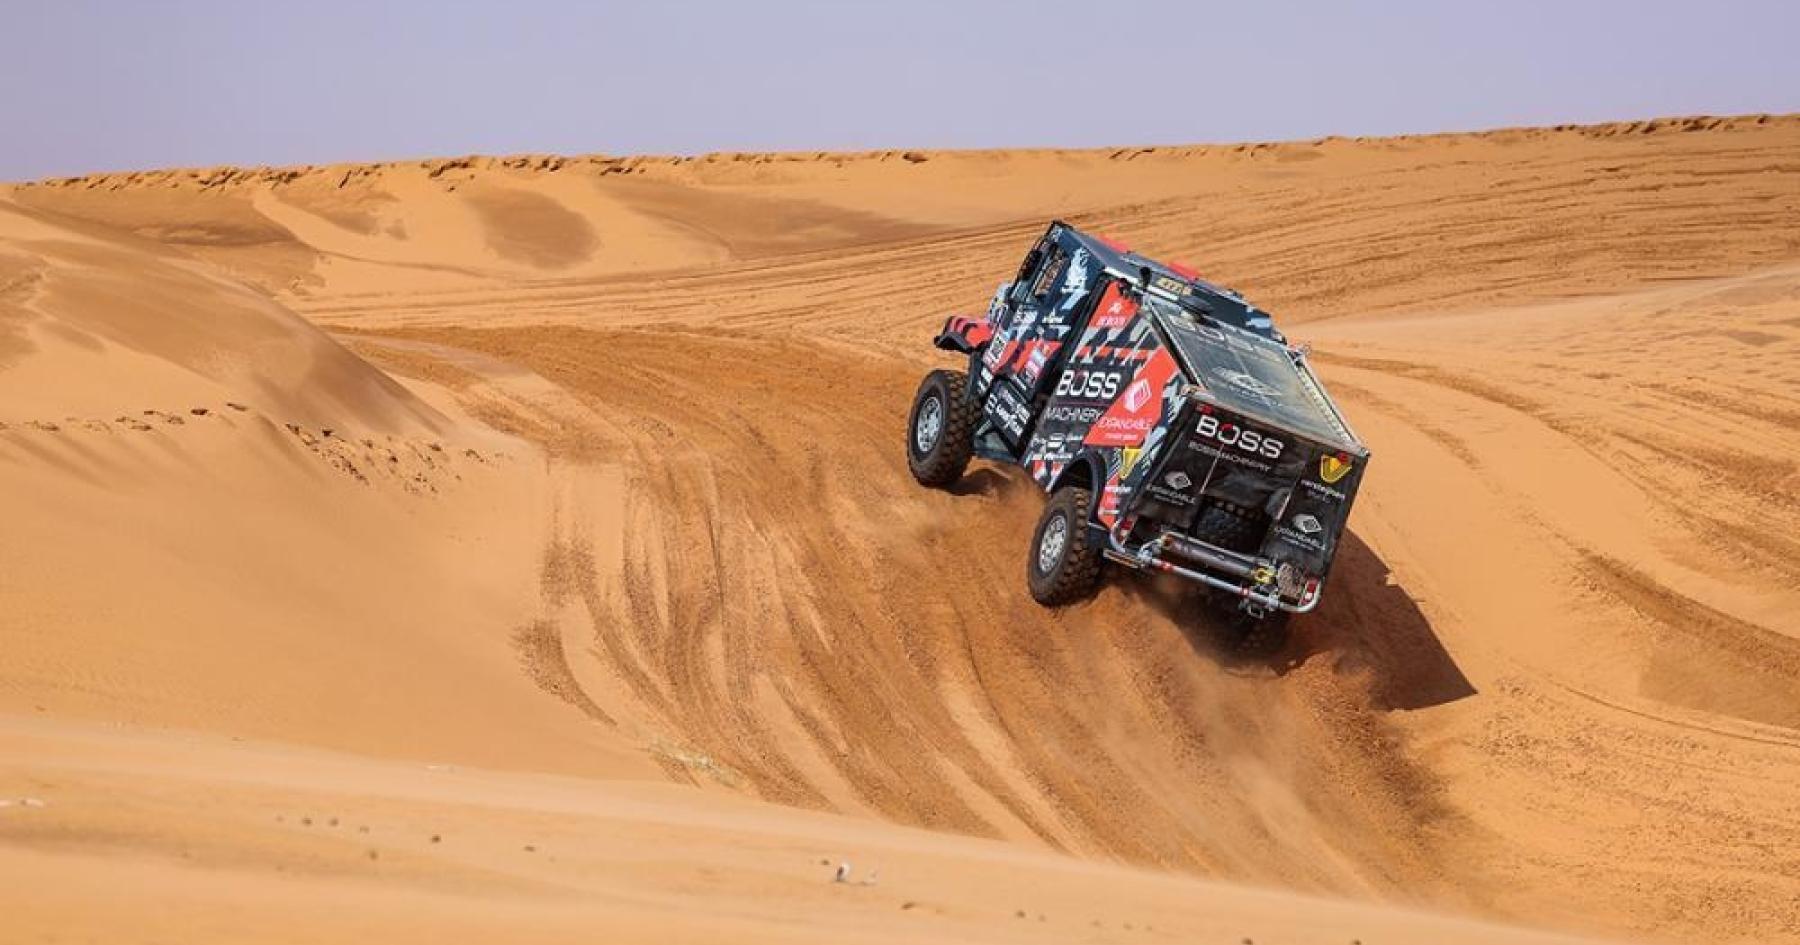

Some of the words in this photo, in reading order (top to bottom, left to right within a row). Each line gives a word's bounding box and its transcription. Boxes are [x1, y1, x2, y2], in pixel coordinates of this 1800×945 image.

[1055, 369, 1120, 399] BOSS
[1043, 407, 1103, 423] MACHINERY
[1196, 414, 1284, 459] BOSS
